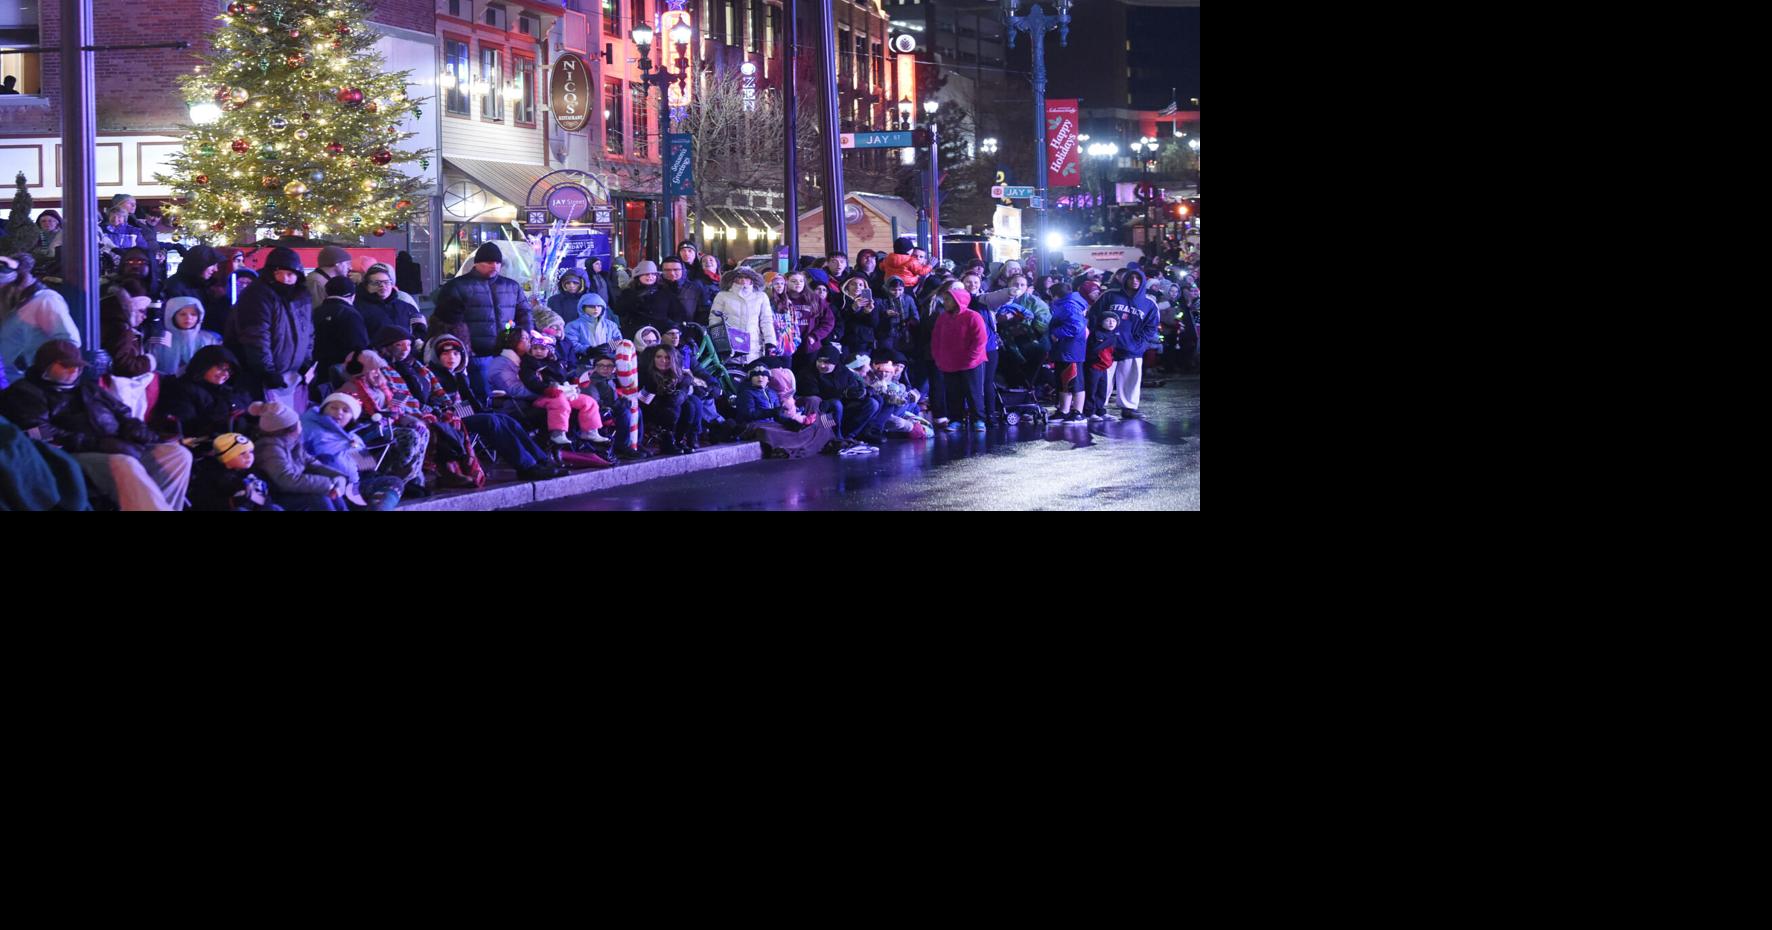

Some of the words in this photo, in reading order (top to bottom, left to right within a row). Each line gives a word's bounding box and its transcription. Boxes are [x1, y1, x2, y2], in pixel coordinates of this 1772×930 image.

[742, 76, 756, 112] ZEN
[866, 135, 889, 144] JAY
[1050, 119, 1073, 149] Happy
[1050, 133, 1077, 173] Holidays
